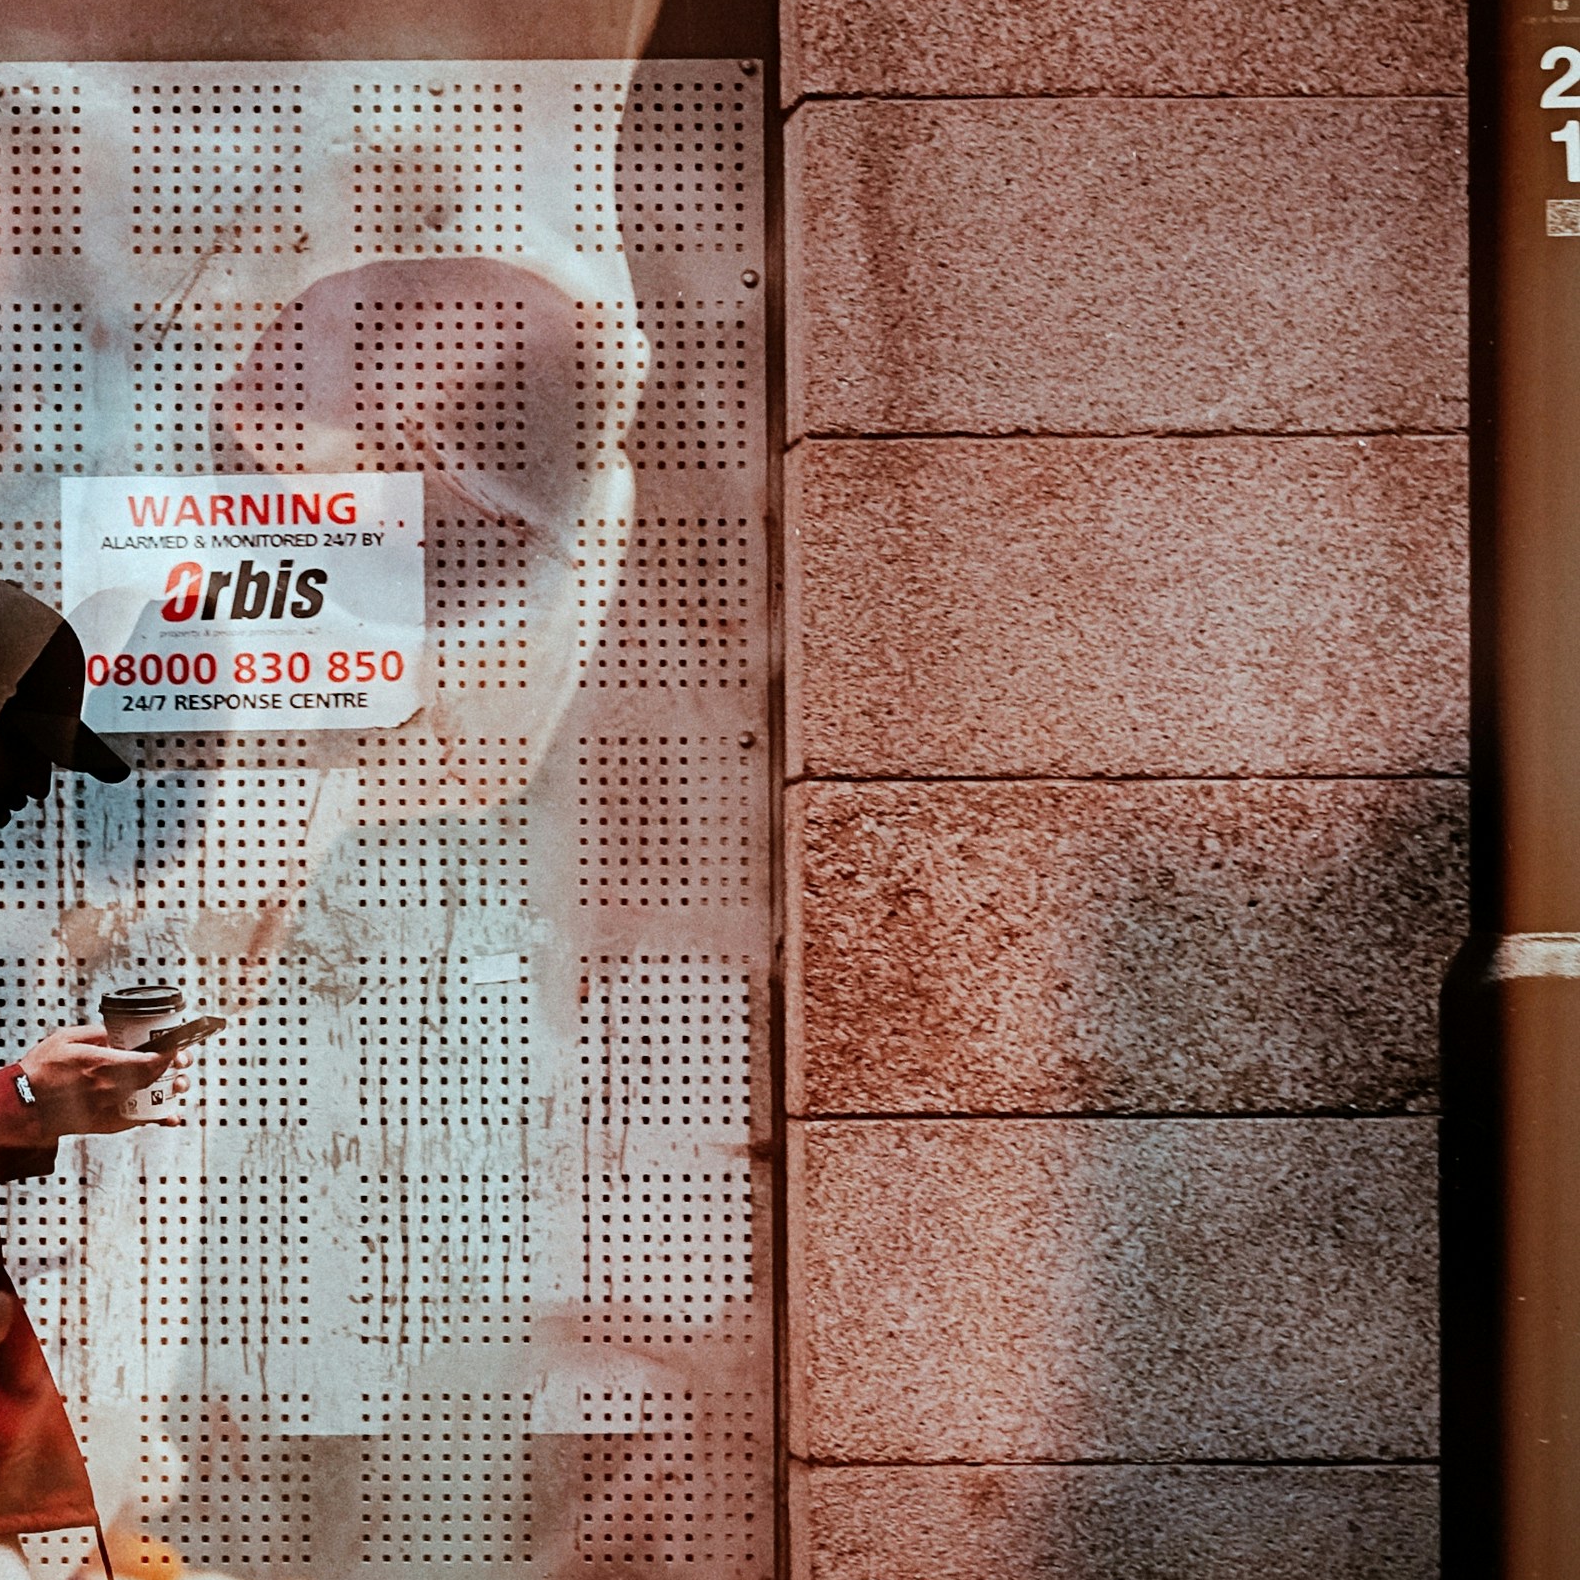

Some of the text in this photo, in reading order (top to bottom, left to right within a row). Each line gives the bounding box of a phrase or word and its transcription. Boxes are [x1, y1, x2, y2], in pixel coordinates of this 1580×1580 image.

[127, 493, 357, 527] WARNING
[101, 532, 385, 550] ALARMED & MONITORED 24/7 BY
[160, 559, 328, 623] Orbis
[87, 650, 405, 687] 08000 830 850
[122, 691, 370, 712] 24/7 RESPONSE CENTRE
